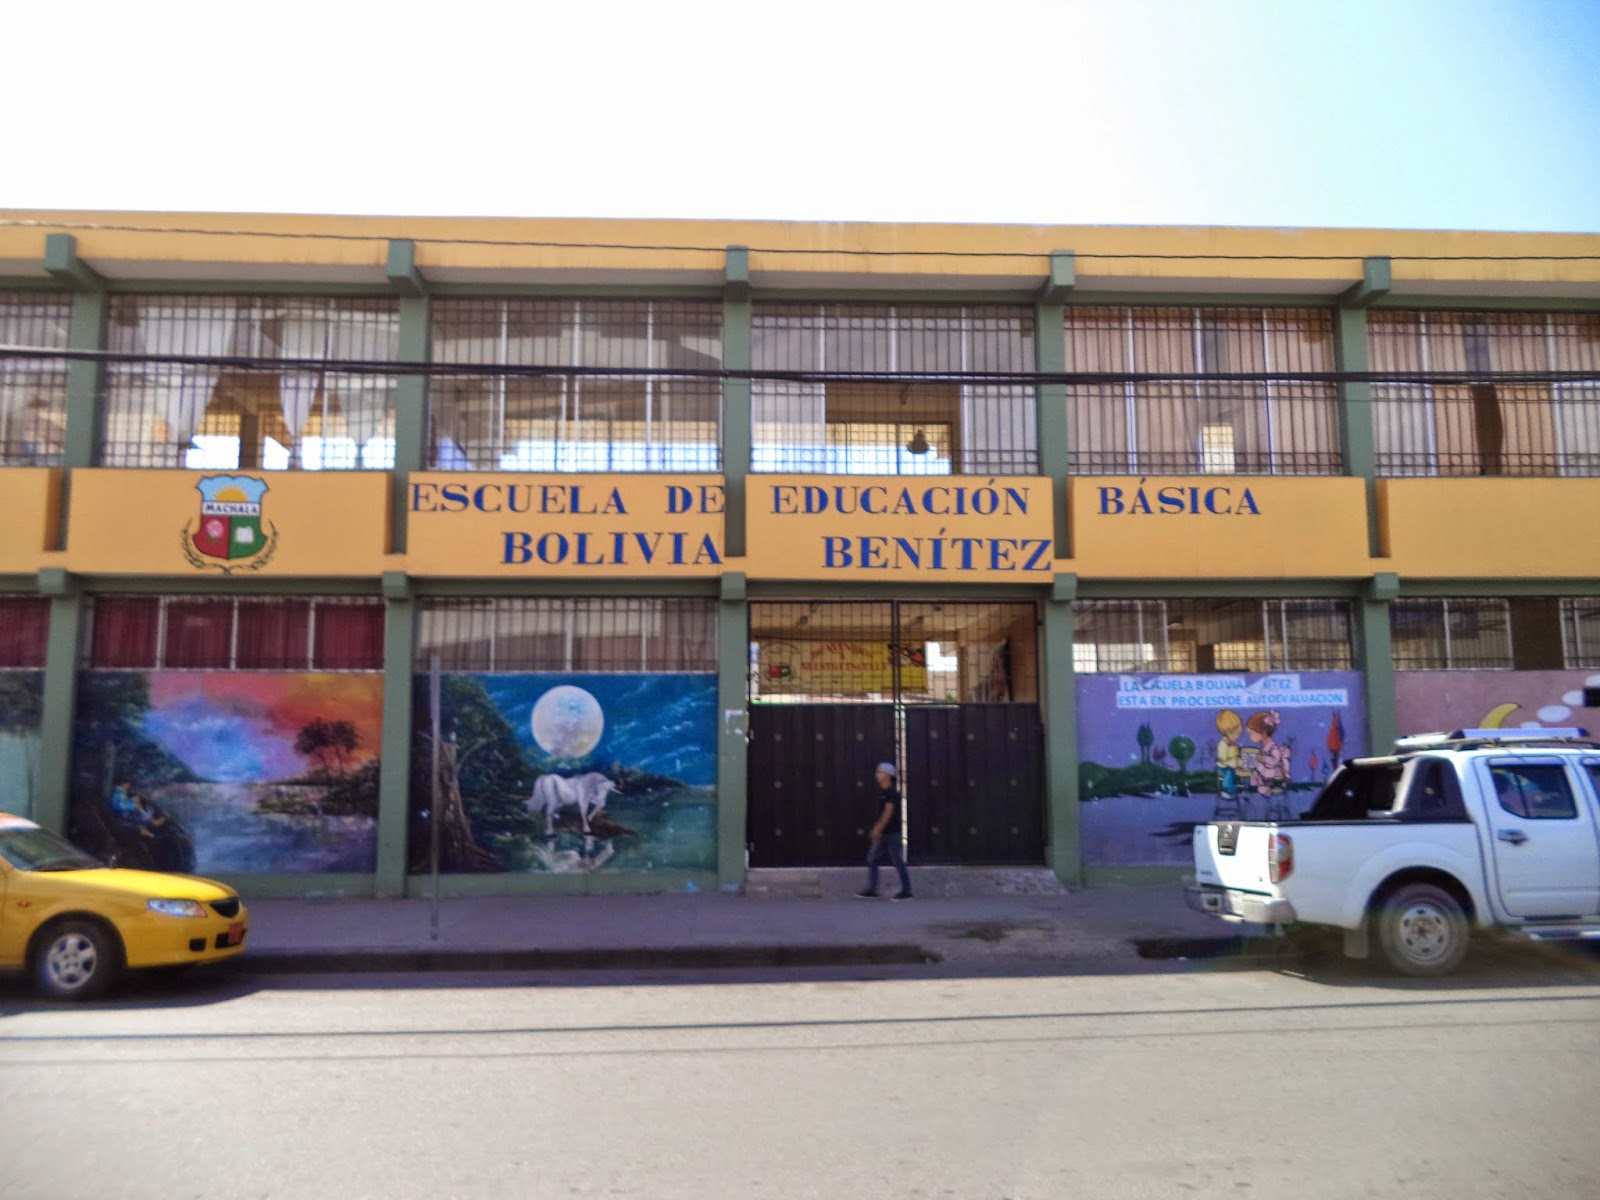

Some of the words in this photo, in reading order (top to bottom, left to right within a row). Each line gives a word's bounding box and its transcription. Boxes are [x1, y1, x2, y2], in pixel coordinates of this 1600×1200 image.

[408, 482, 628, 515] ESCUELA
[664, 485, 725, 514] DE
[769, 478, 1030, 516] EDUCACIÓN
[1096, 477, 1262, 515] BÁSICA
[205, 504, 258, 513] MACHALA
[500, 531, 724, 565] BOLIVIA
[820, 528, 1052, 571] BENÍTEZ
[1123, 680, 1140, 692] LA
[1118, 695, 1148, 706] ESTA
[1150, 695, 1166, 706] EN
